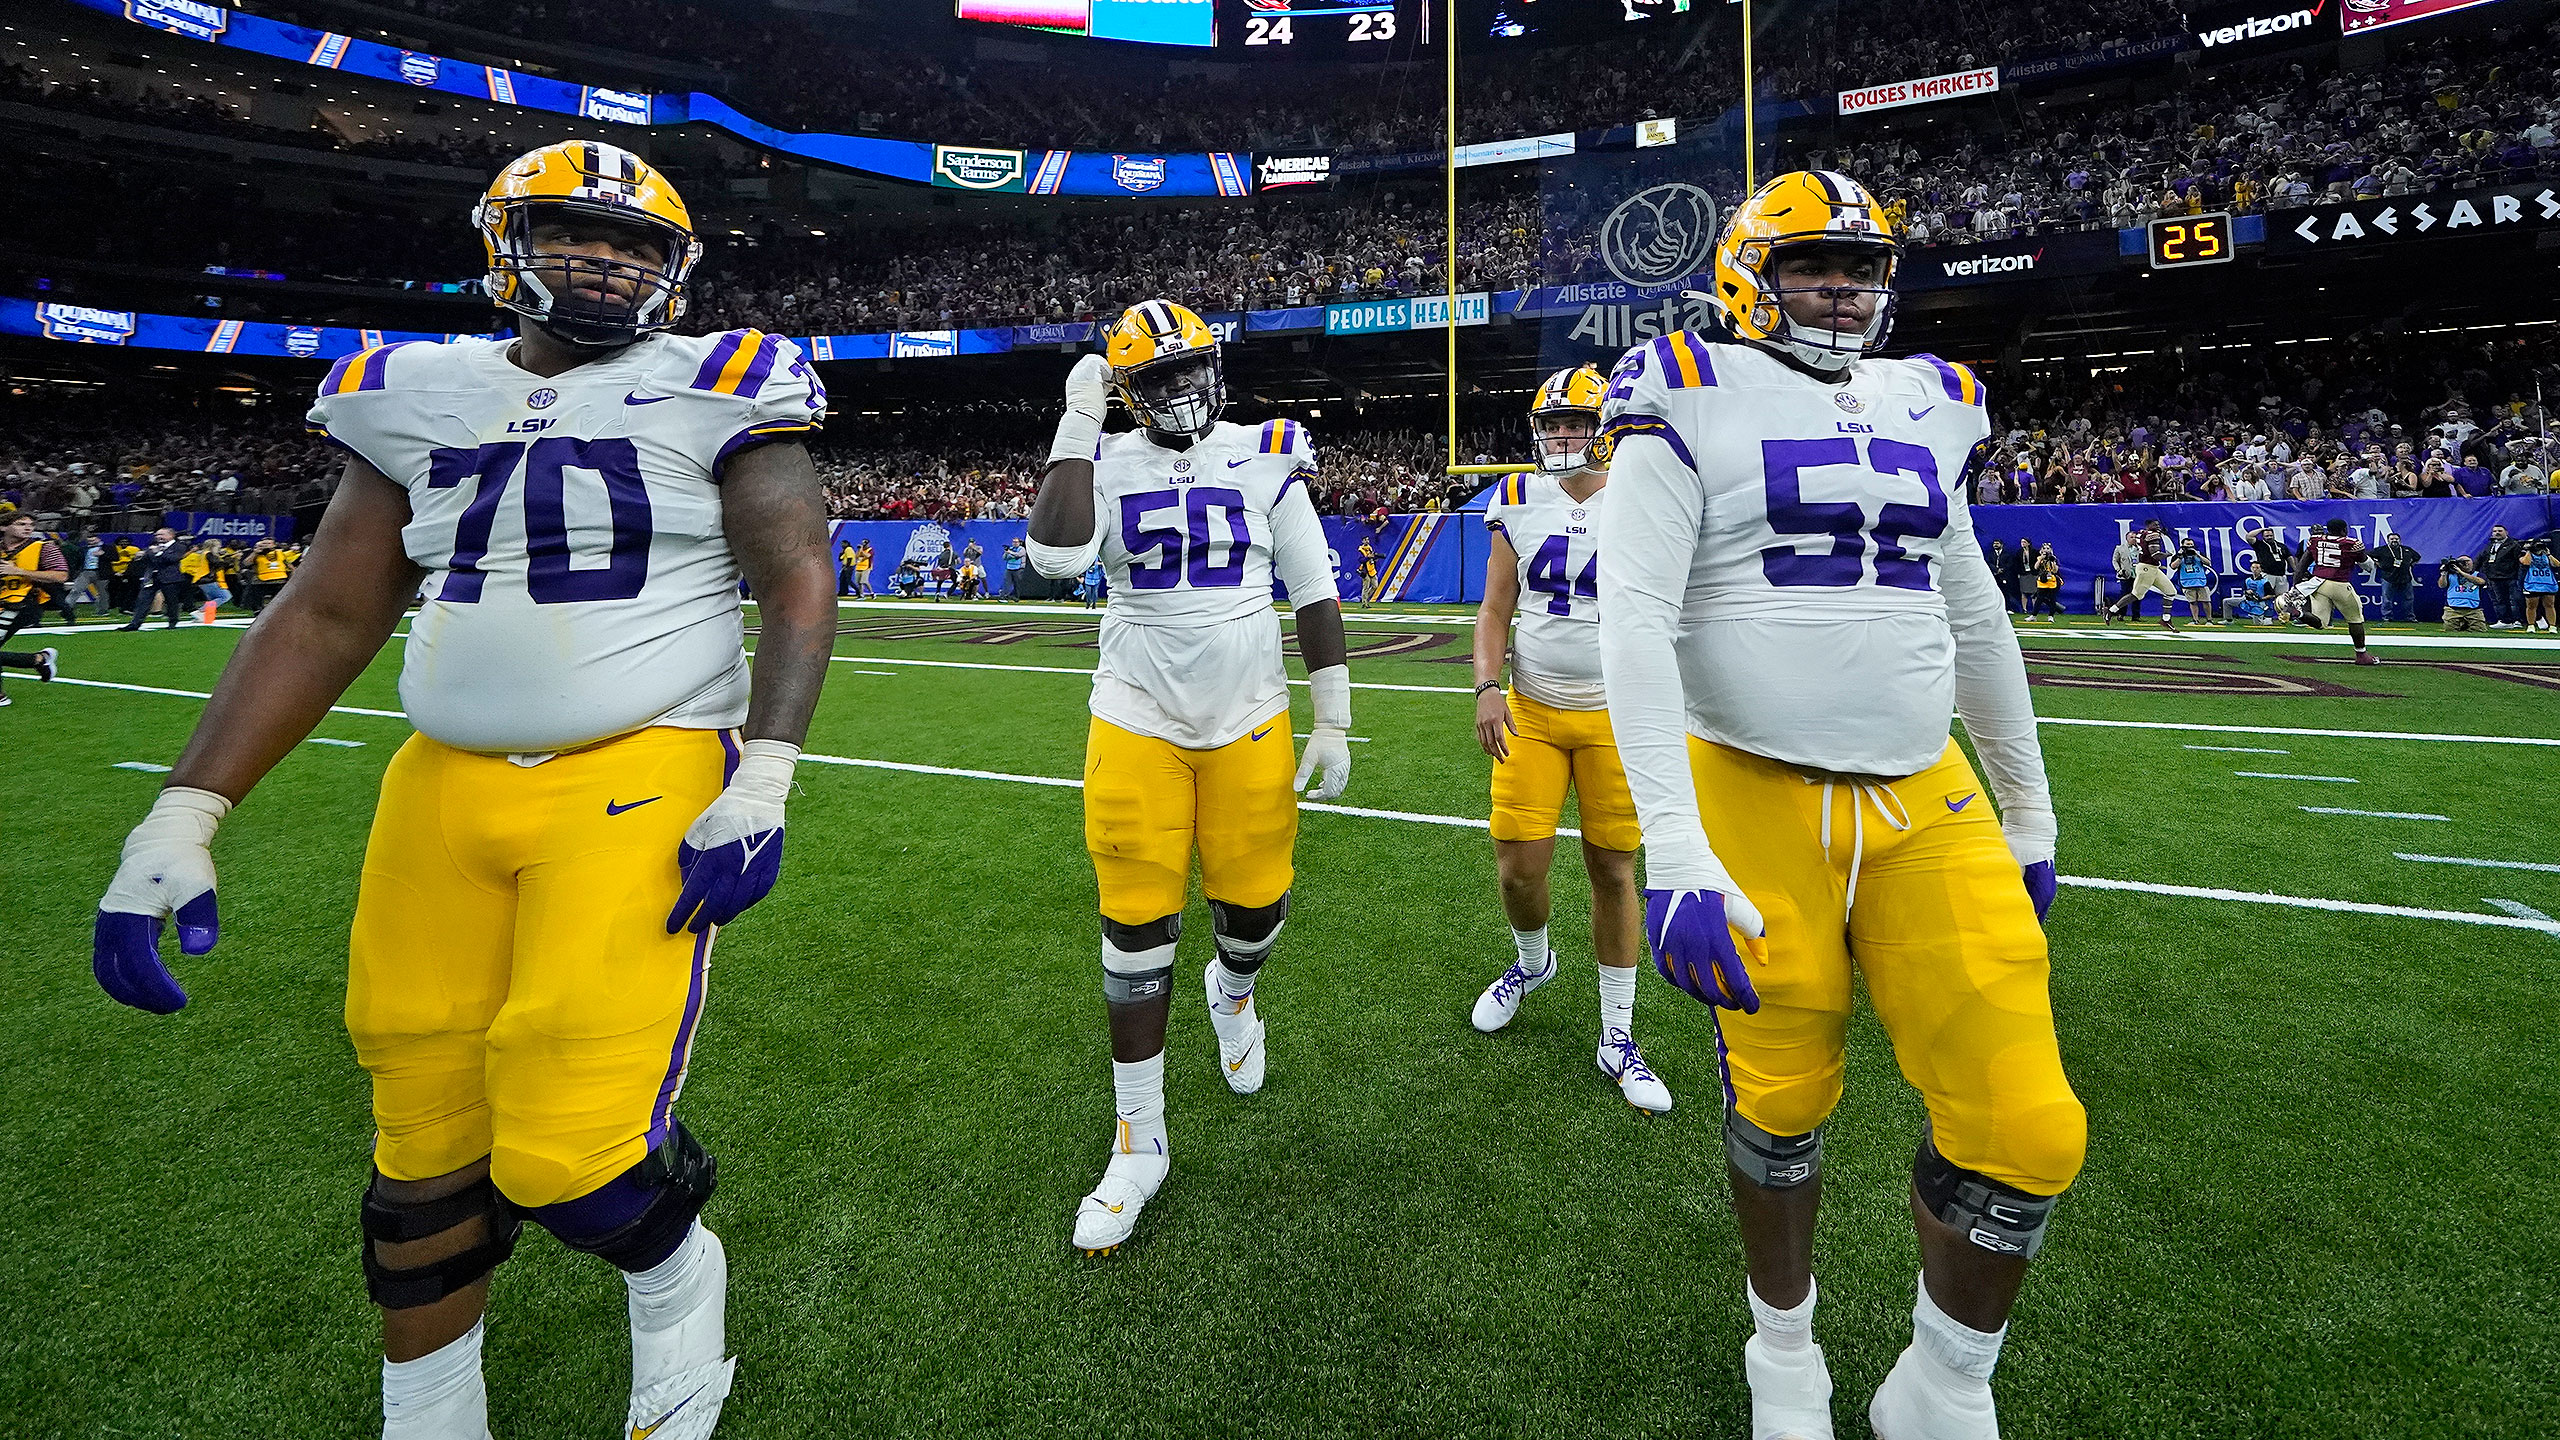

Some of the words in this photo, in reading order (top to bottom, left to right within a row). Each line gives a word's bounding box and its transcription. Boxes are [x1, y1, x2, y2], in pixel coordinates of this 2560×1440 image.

[1244, 16, 1294, 46] 24
[1347, 11, 1397, 42] 23
[2199, 8, 2312, 48] verizon
[2006, 60, 2058, 79] Allstate
[2115, 38, 2181, 58] KICKOFF
[1842, 85, 1906, 111] ROUSES
[1912, 71, 1994, 99] MARKETS
[946, 153, 1012, 170] Sanderson
[960, 166, 1001, 180] Farms
[1840, 218, 1871, 231] LSU
[2294, 188, 2560, 244] CAESARS
[2164, 221, 2219, 260] 25
[1942, 252, 2034, 278] verizon
[1555, 283, 1627, 304] Allstate
[1329, 304, 1407, 331] PEOPLES
[1567, 297, 1714, 348] Allsta
[1162, 340, 1184, 354] LSU
[506, 418, 558, 434] LSU
[1836, 421, 1874, 434] LSU
[1169, 475, 1196, 485] LSU
[197, 517, 266, 536] Allstate
[428, 436, 654, 605] 70
[1761, 436, 1949, 592] 52
[1120, 487, 1252, 590] 50
[1565, 525, 1587, 535] LSU
[2317, 547, 2342, 568] 15
